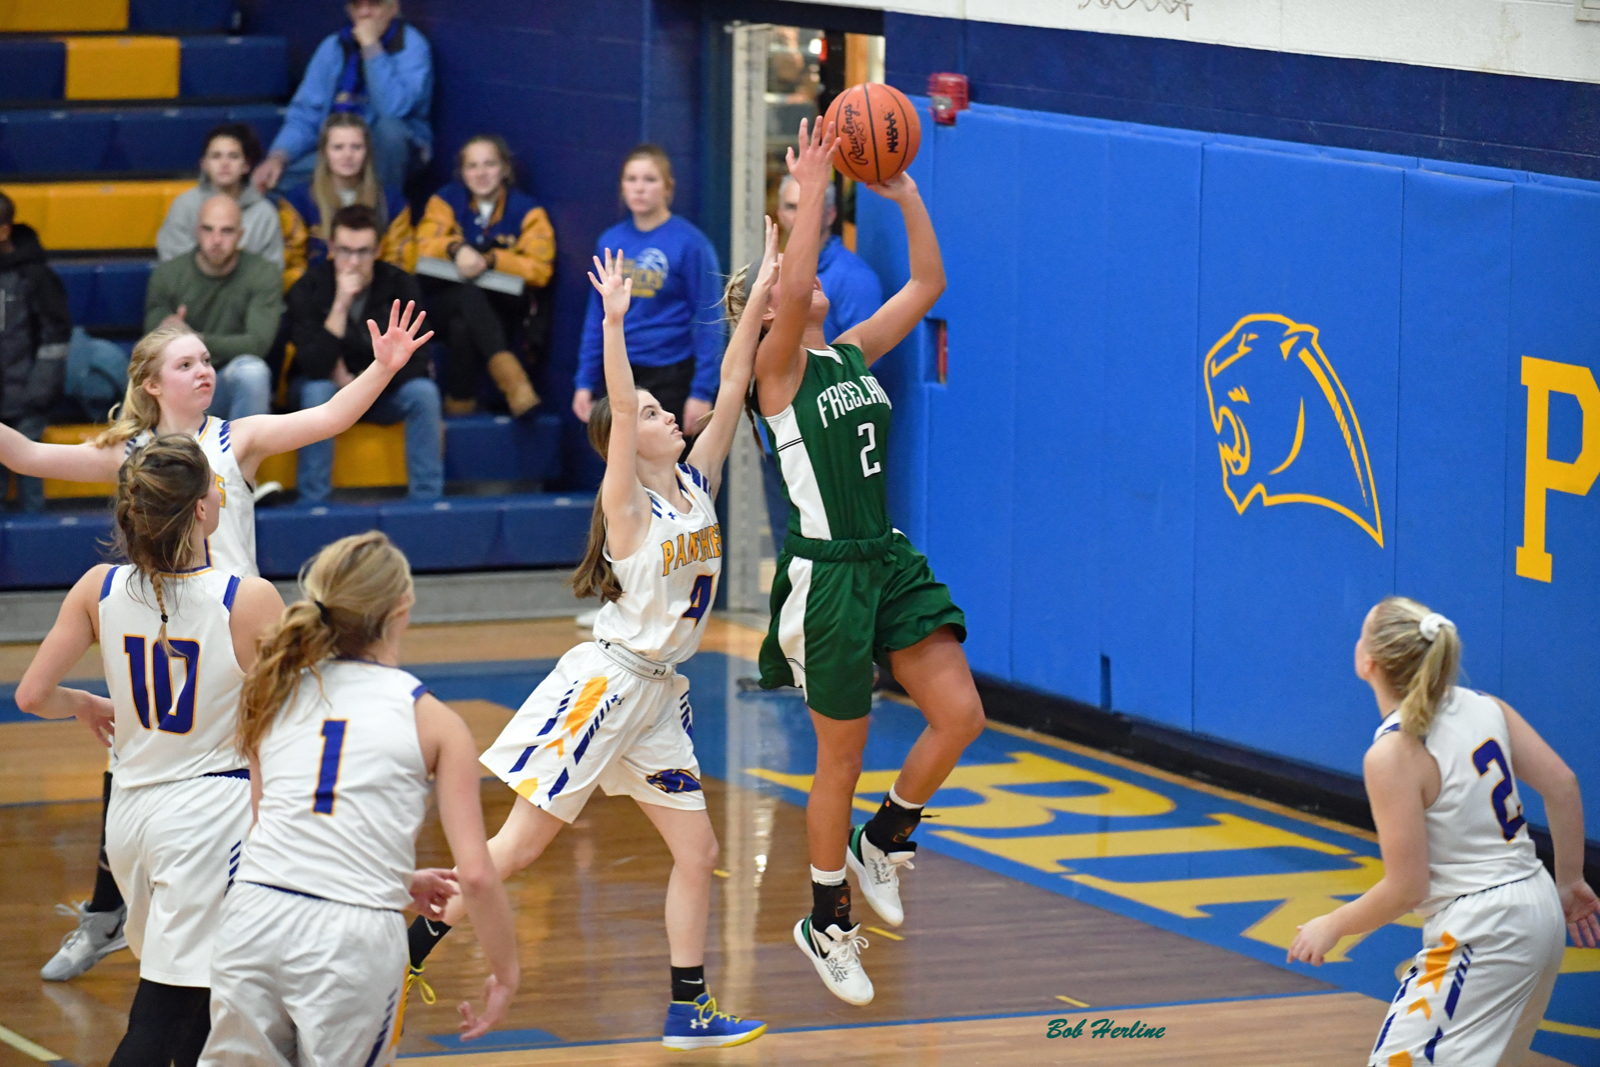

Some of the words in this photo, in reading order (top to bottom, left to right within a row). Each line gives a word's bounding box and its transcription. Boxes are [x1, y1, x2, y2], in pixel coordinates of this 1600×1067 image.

[841, 103, 869, 165] Rawlings
[857, 422, 881, 478] 2
[1516, 355, 1600, 583] P
[681, 573, 715, 631] 4
[122, 633, 200, 736] 10
[312, 718, 349, 816] 1
[1471, 737, 1526, 845] 2
